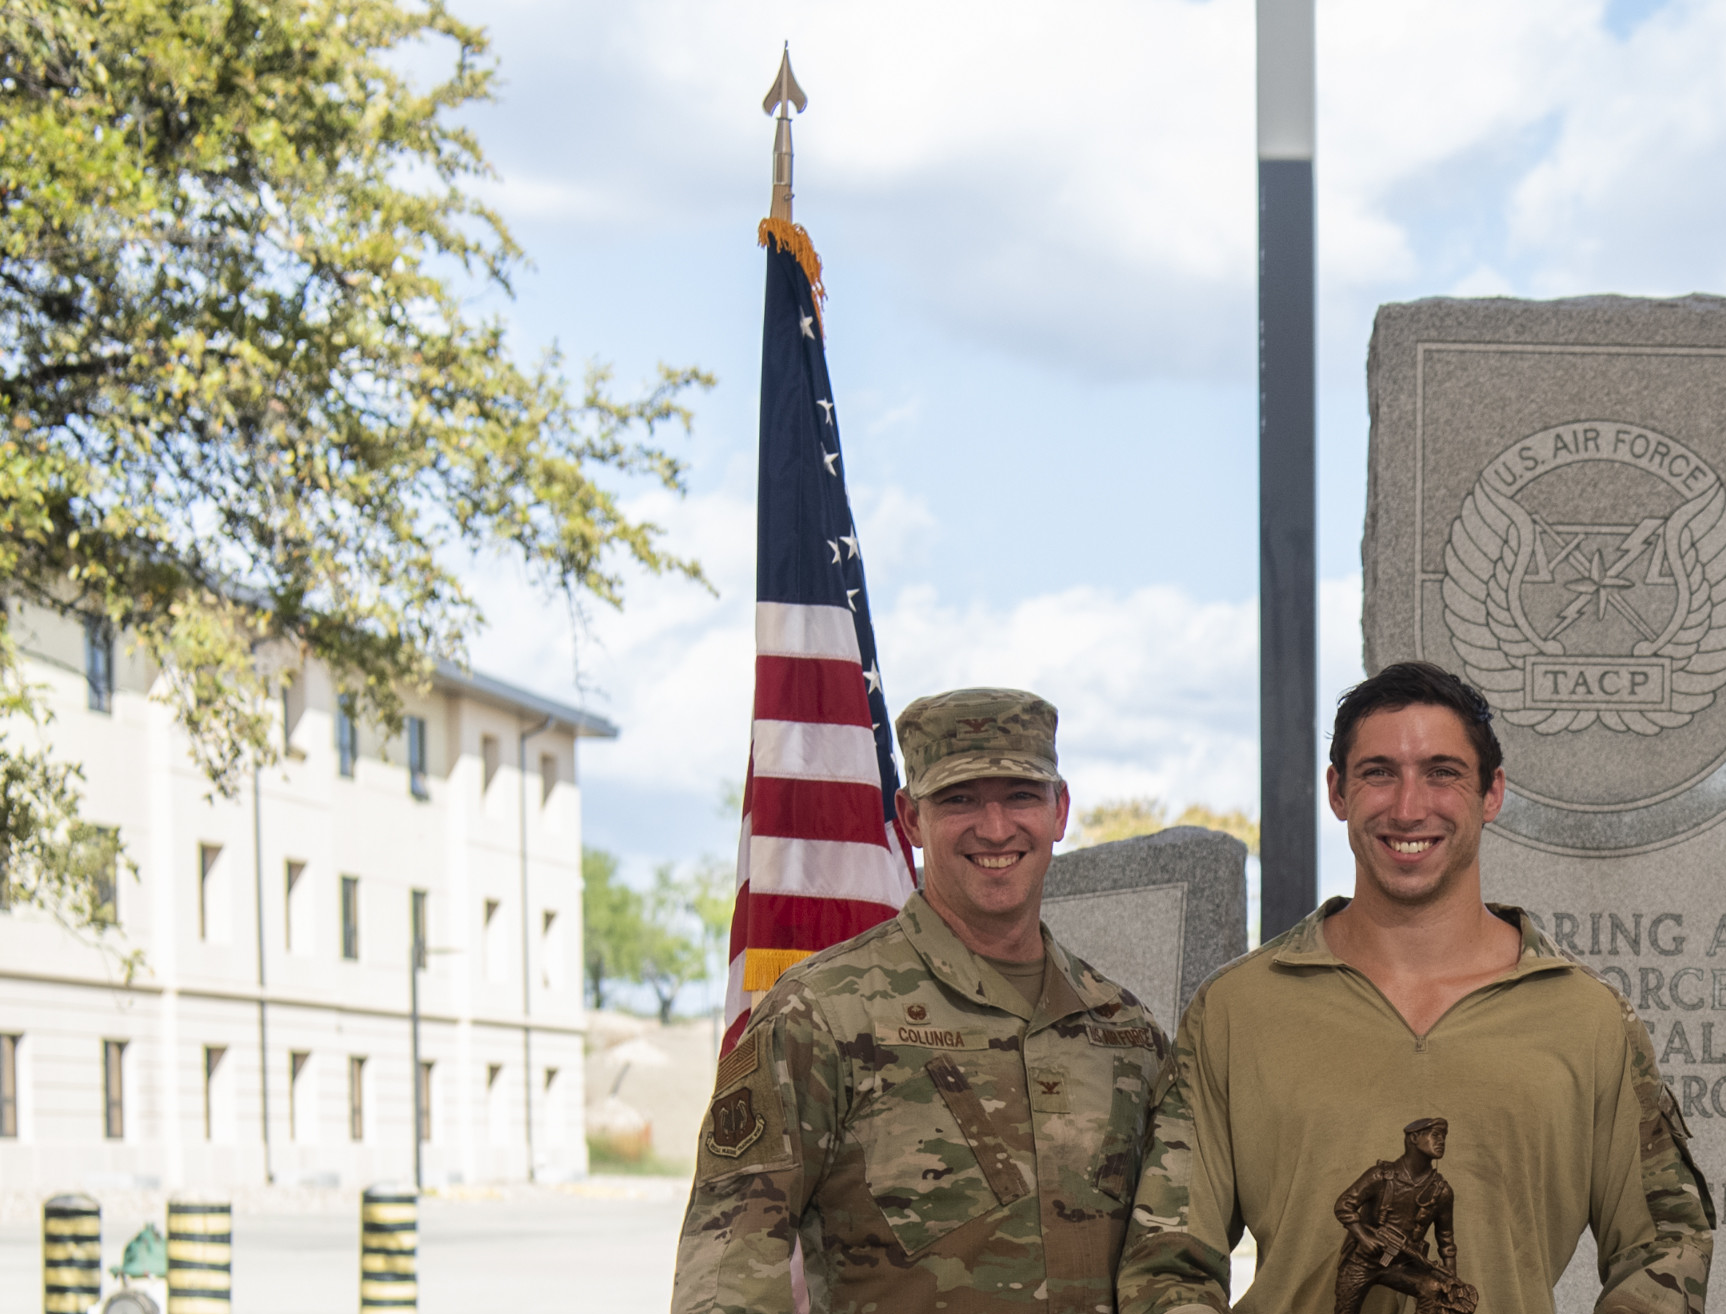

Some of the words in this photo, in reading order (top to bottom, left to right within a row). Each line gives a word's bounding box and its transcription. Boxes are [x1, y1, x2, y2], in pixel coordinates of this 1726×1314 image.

[1494, 446, 1546, 488] U.S.
[1553, 428, 1600, 460] AIR
[1613, 429, 1708, 492] FORCE
[1542, 669, 1650, 697] TACP
[898, 1027, 966, 1047] COLUNGA
